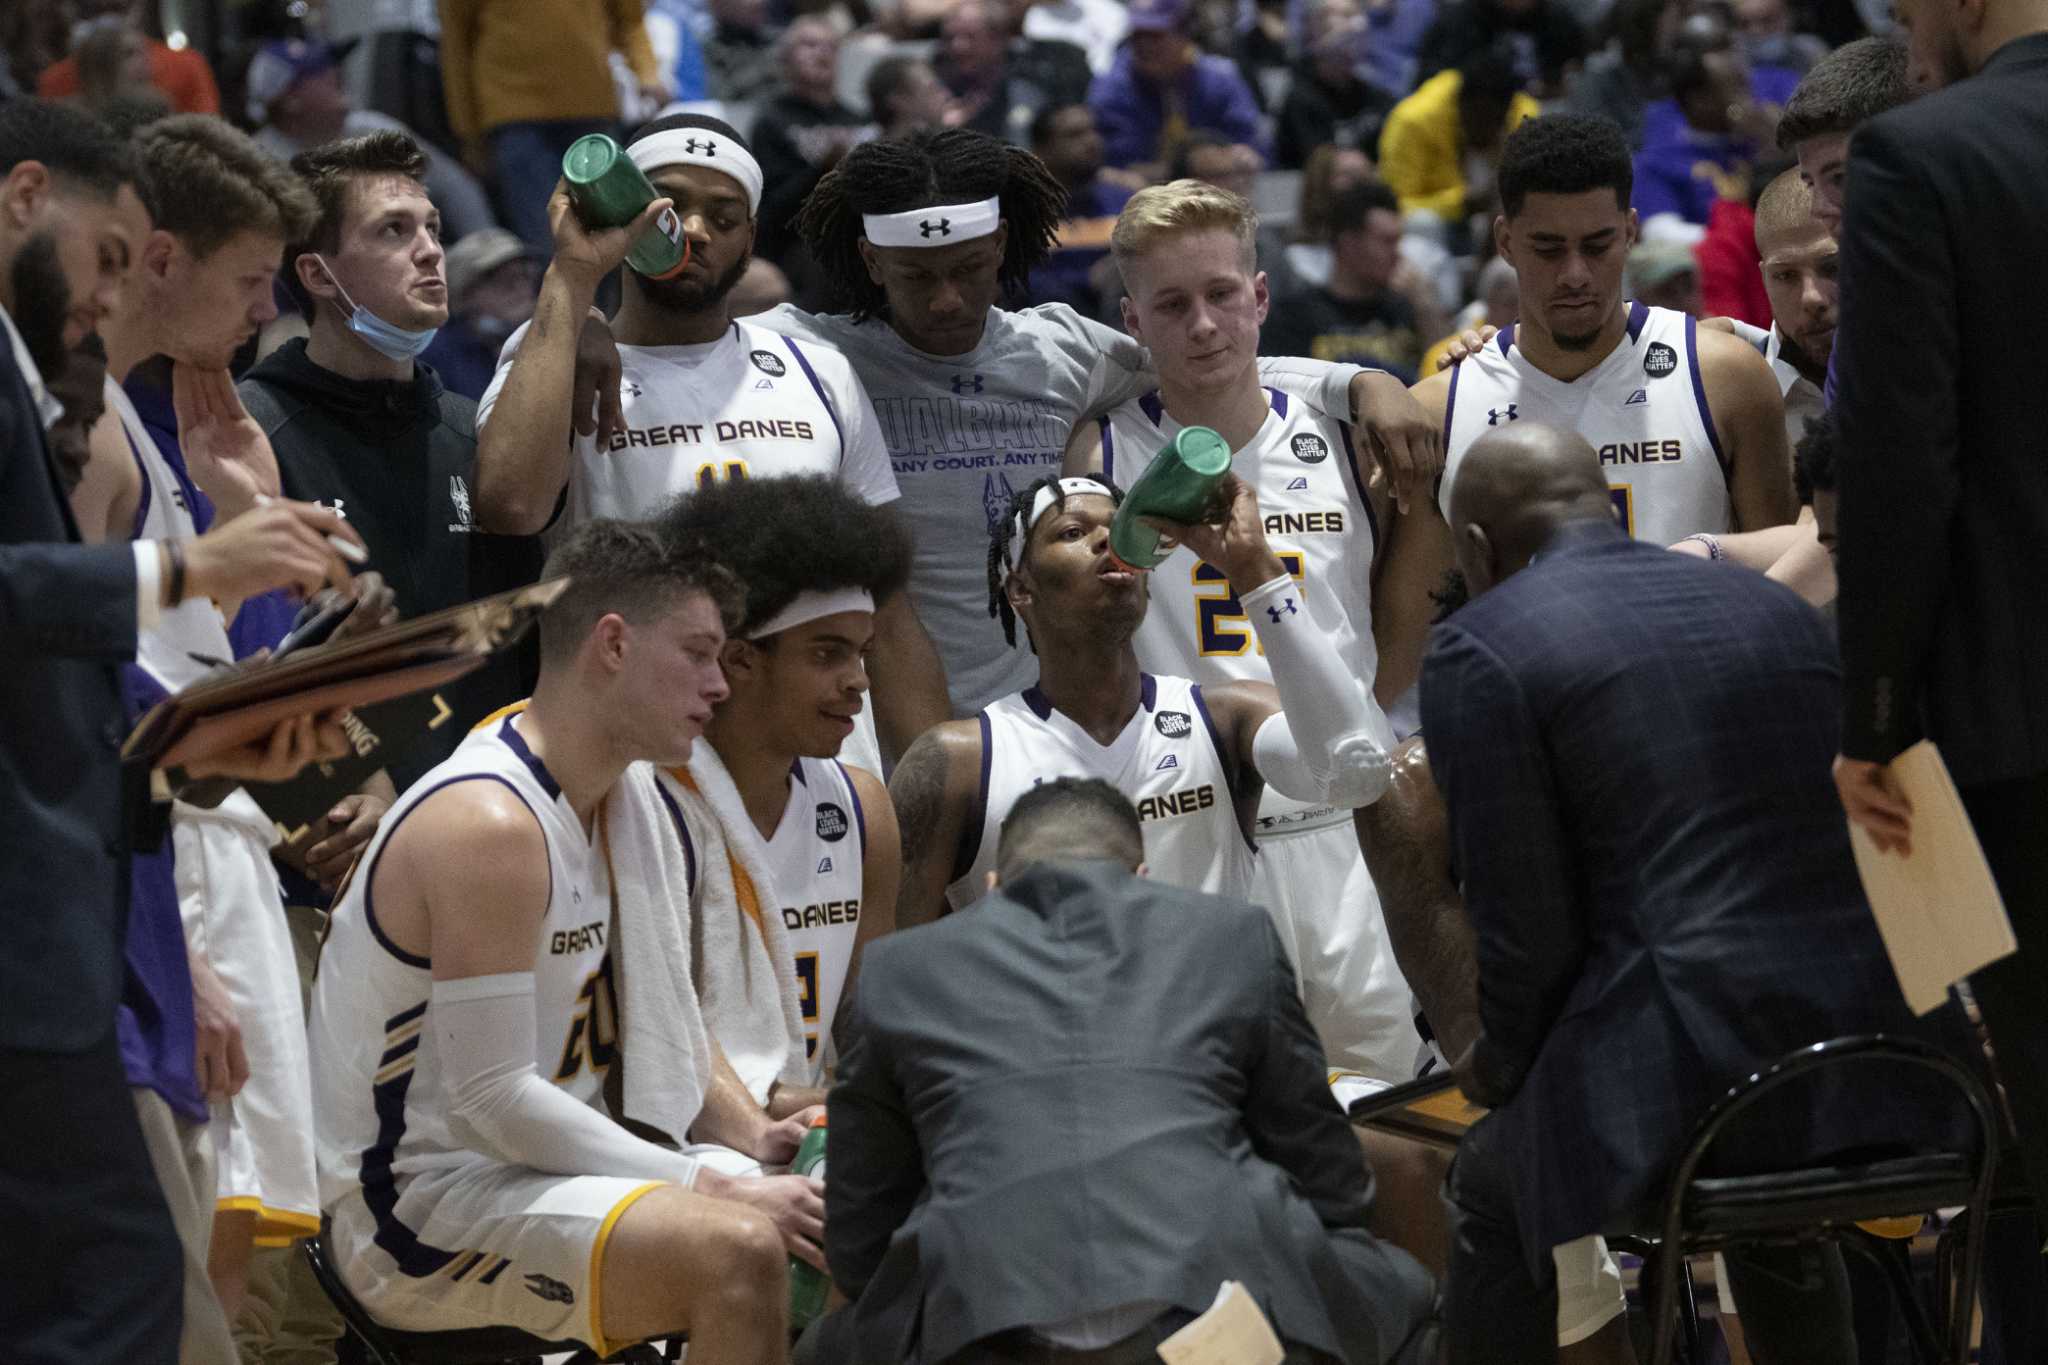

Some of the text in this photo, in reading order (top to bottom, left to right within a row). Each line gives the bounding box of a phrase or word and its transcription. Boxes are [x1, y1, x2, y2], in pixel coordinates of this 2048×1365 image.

[609, 420, 814, 452] GREAT DANES
[933, 454, 1000, 471] COURT.
[1004, 453, 1038, 465] ANY
[1599, 440, 1681, 465] ANES
[1265, 513, 1343, 534] ANES
[1137, 785, 1214, 822] ANES
[782, 900, 858, 929] DANES
[551, 921, 604, 954] GRAT
